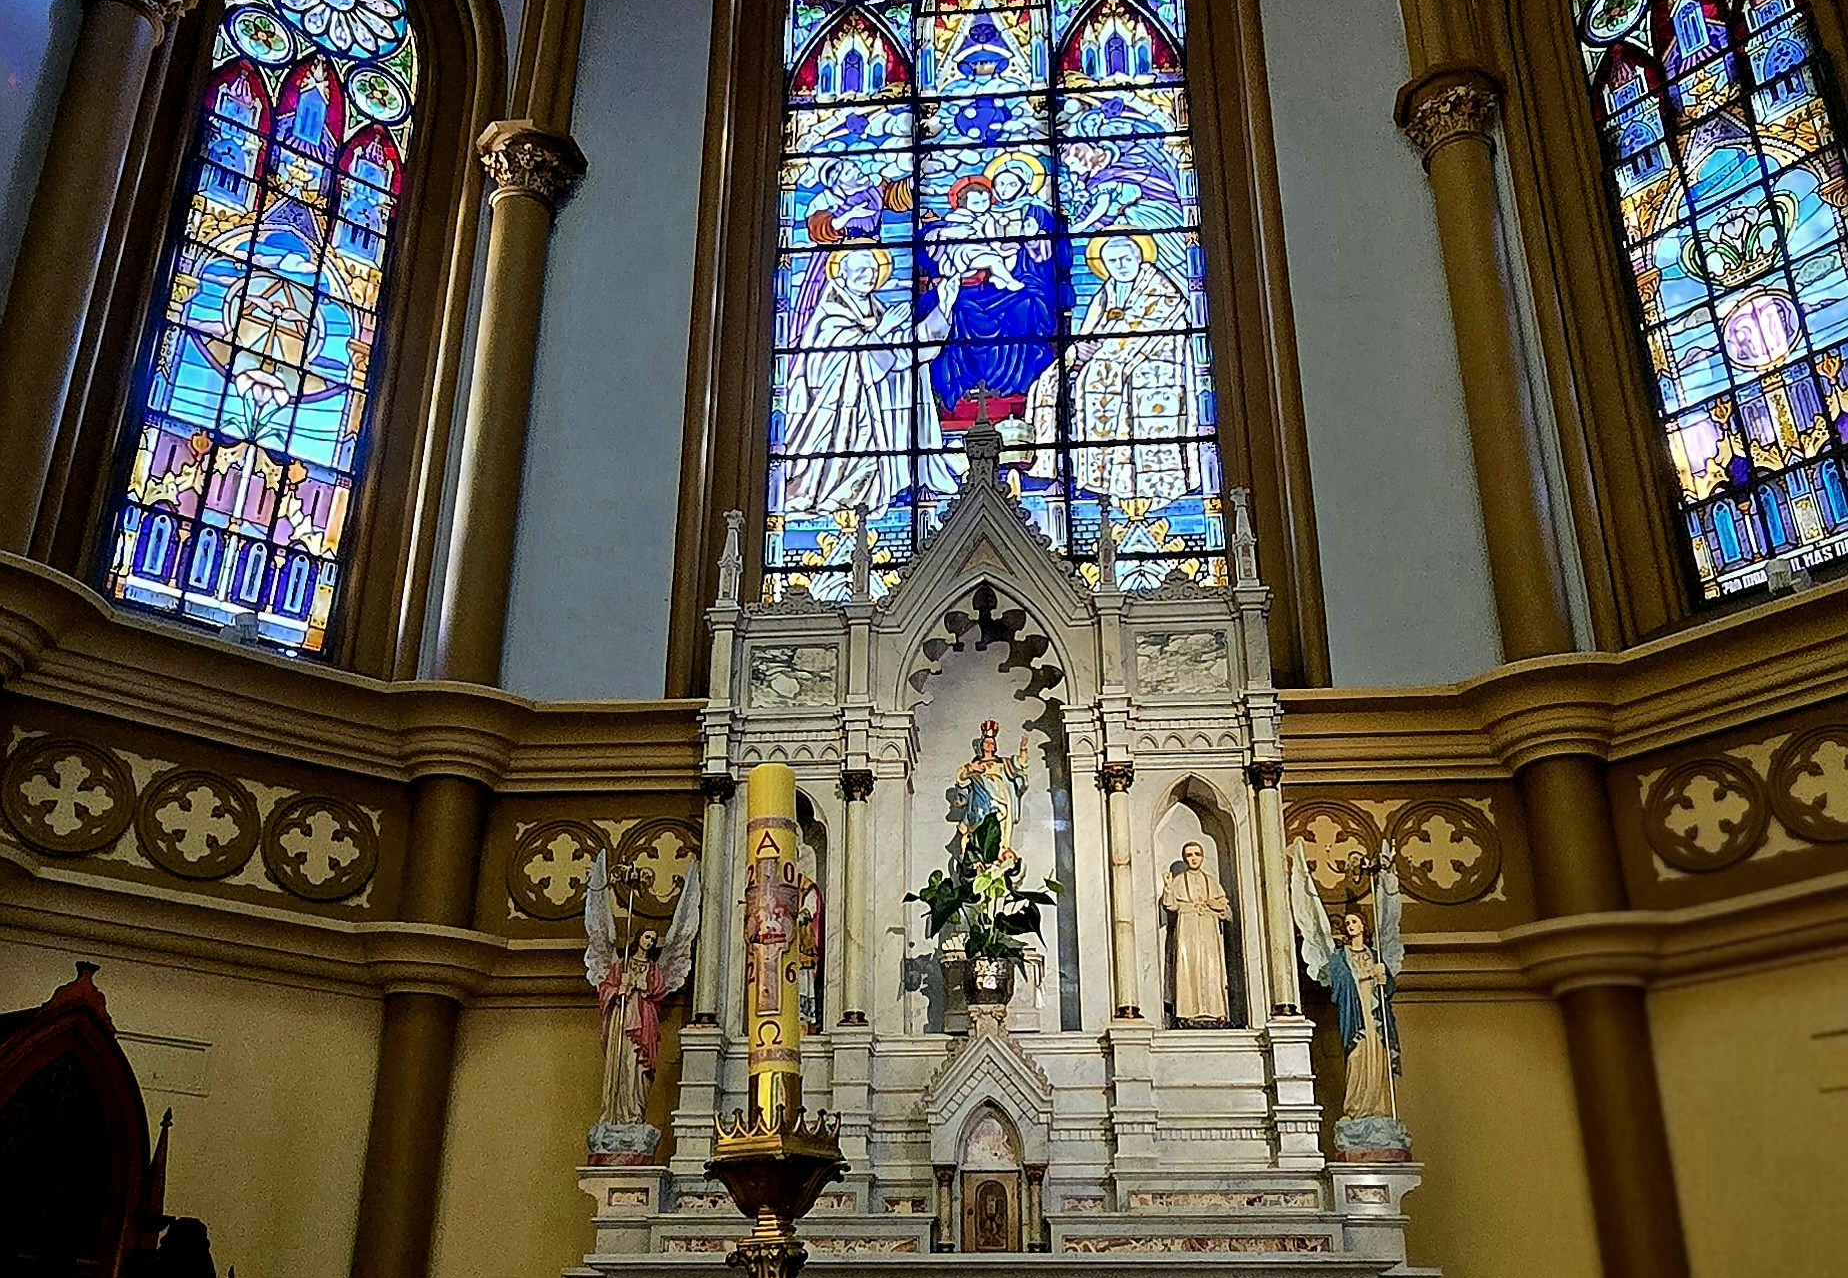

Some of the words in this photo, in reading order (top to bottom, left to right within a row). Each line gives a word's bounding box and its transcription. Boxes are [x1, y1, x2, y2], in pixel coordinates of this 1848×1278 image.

[756, 830, 781, 855] A
[747, 864, 756, 886] 2
[783, 861, 795, 884] 0
[747, 962, 756, 984] 2
[785, 961, 797, 983] 6
[755, 1020, 783, 1048] Ω
